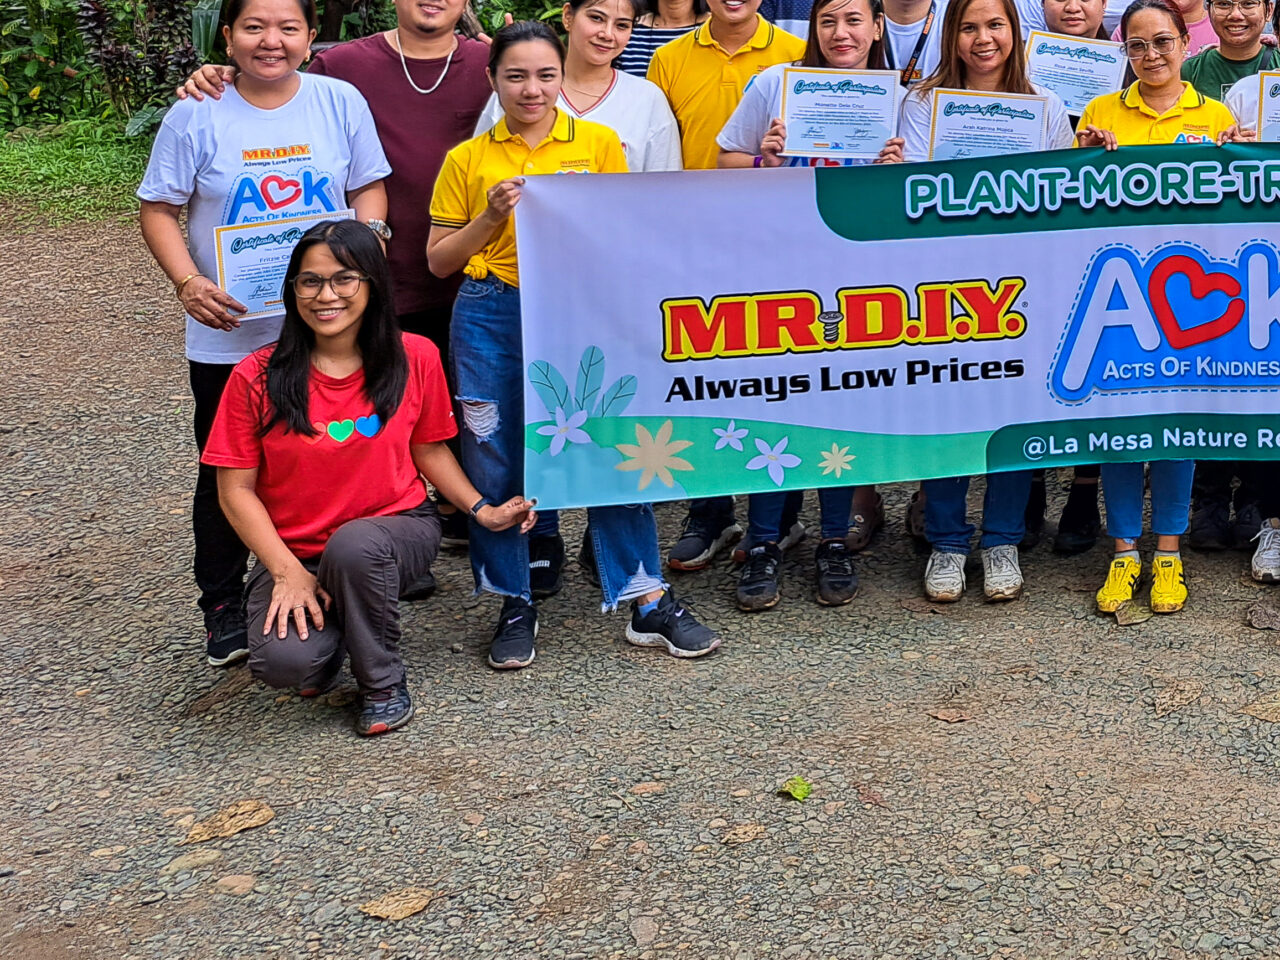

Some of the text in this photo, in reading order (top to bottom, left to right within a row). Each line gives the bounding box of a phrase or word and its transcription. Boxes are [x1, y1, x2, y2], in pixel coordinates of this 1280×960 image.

[288, 156, 312, 164] Prices
[665, 358, 1025, 403] Always Low Prices
[1102, 359, 1156, 381] ACTS
[1159, 356, 1192, 378] OF
[1088, 431, 1154, 453] Mesa
[1163, 428, 1248, 449] Nature
